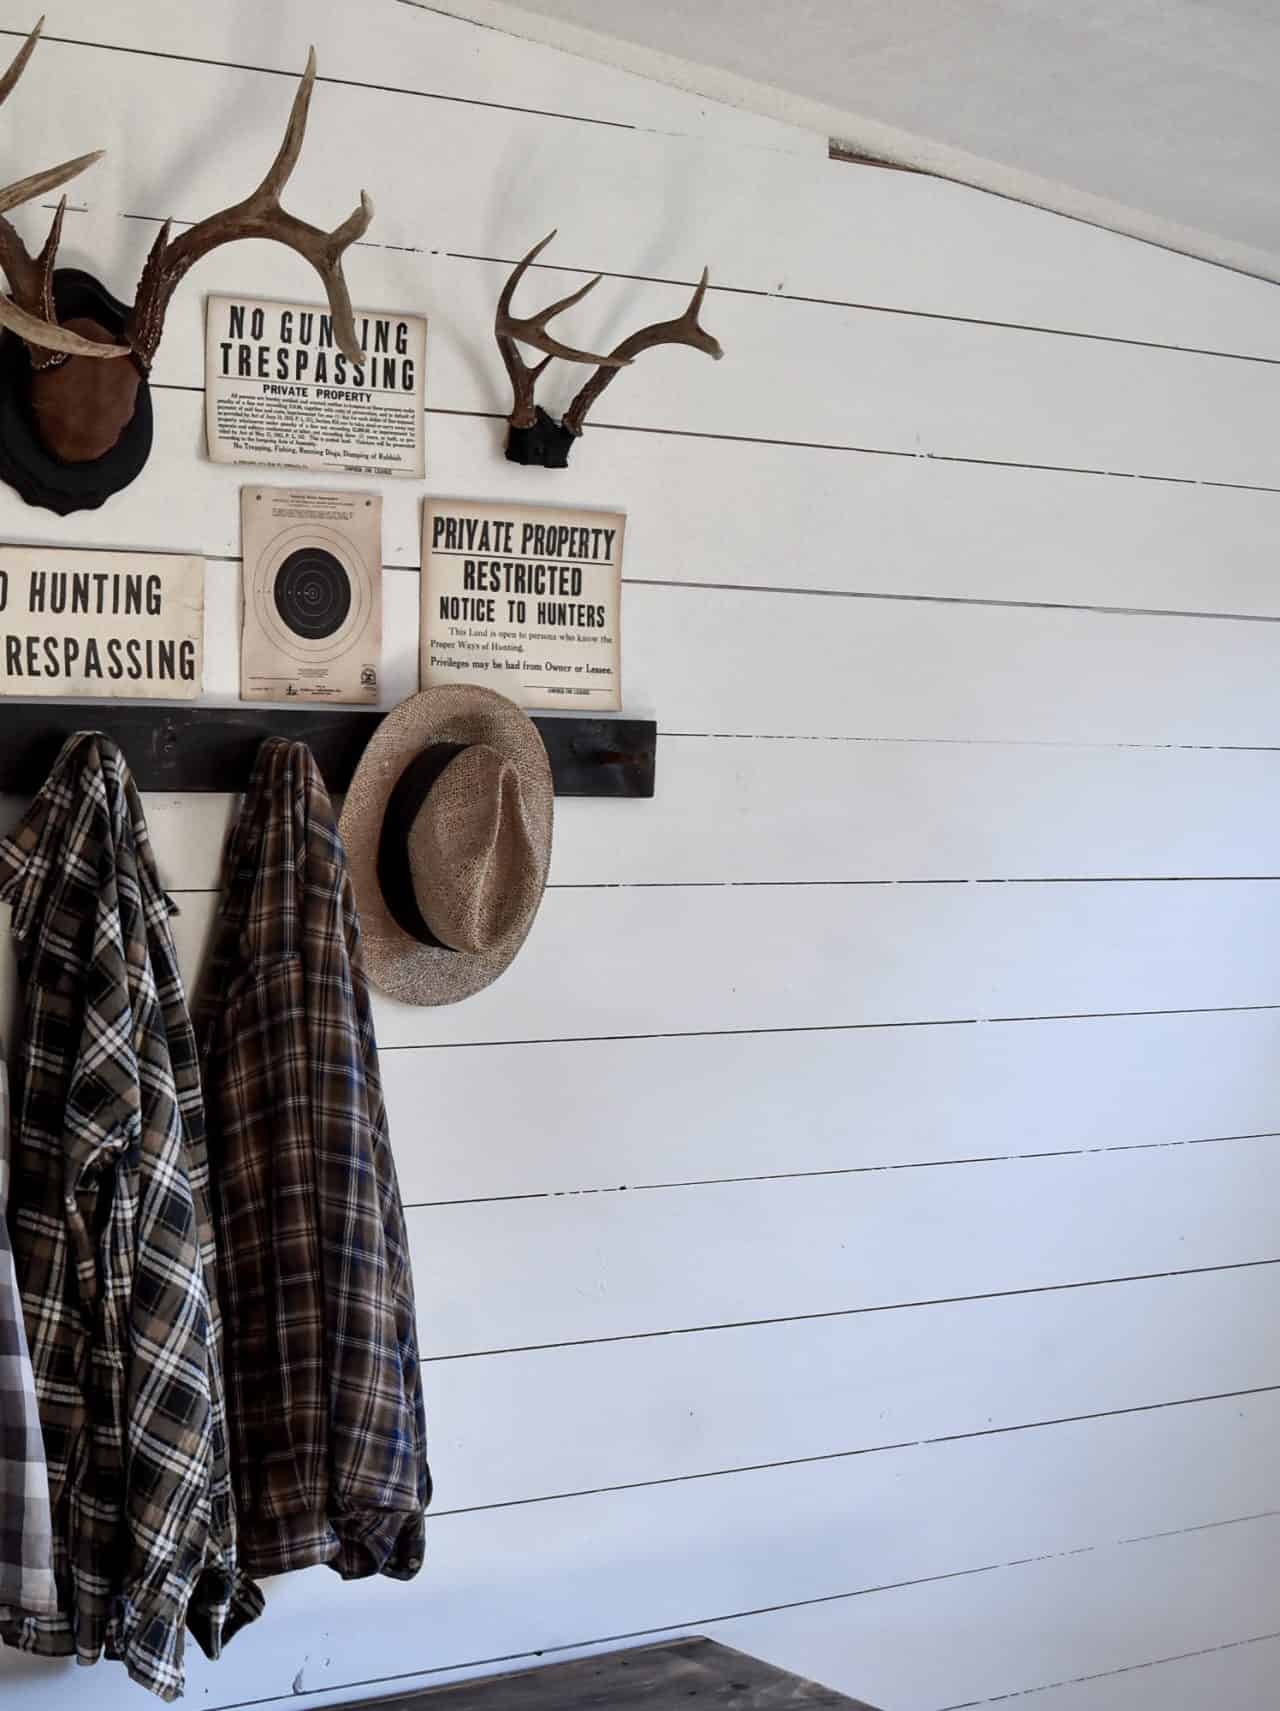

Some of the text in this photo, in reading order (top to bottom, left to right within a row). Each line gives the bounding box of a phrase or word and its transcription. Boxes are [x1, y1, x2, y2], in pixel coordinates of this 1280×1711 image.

[229, 305, 408, 355] NO GUNING
[220, 343, 414, 391] TRESPASSING
[263, 384, 372, 403] PRIVATE PROPERTY
[432, 516, 616, 561] PRIVATE PROPERTY
[28, 571, 162, 616] HUNTING
[463, 559, 583, 597] RESTRICTED
[439, 596, 605, 628] NOTICE TO HUNTERS
[448, 627, 466, 636] This
[600, 633, 613, 644] the
[430, 656, 469, 669] Privileges
[472, 660, 489, 671] may
[492, 659, 502, 669] be
[505, 660, 520, 670] had
[523, 661, 542, 671] from
[545, 662, 571, 673] Owner
[574, 664, 583, 673] or
